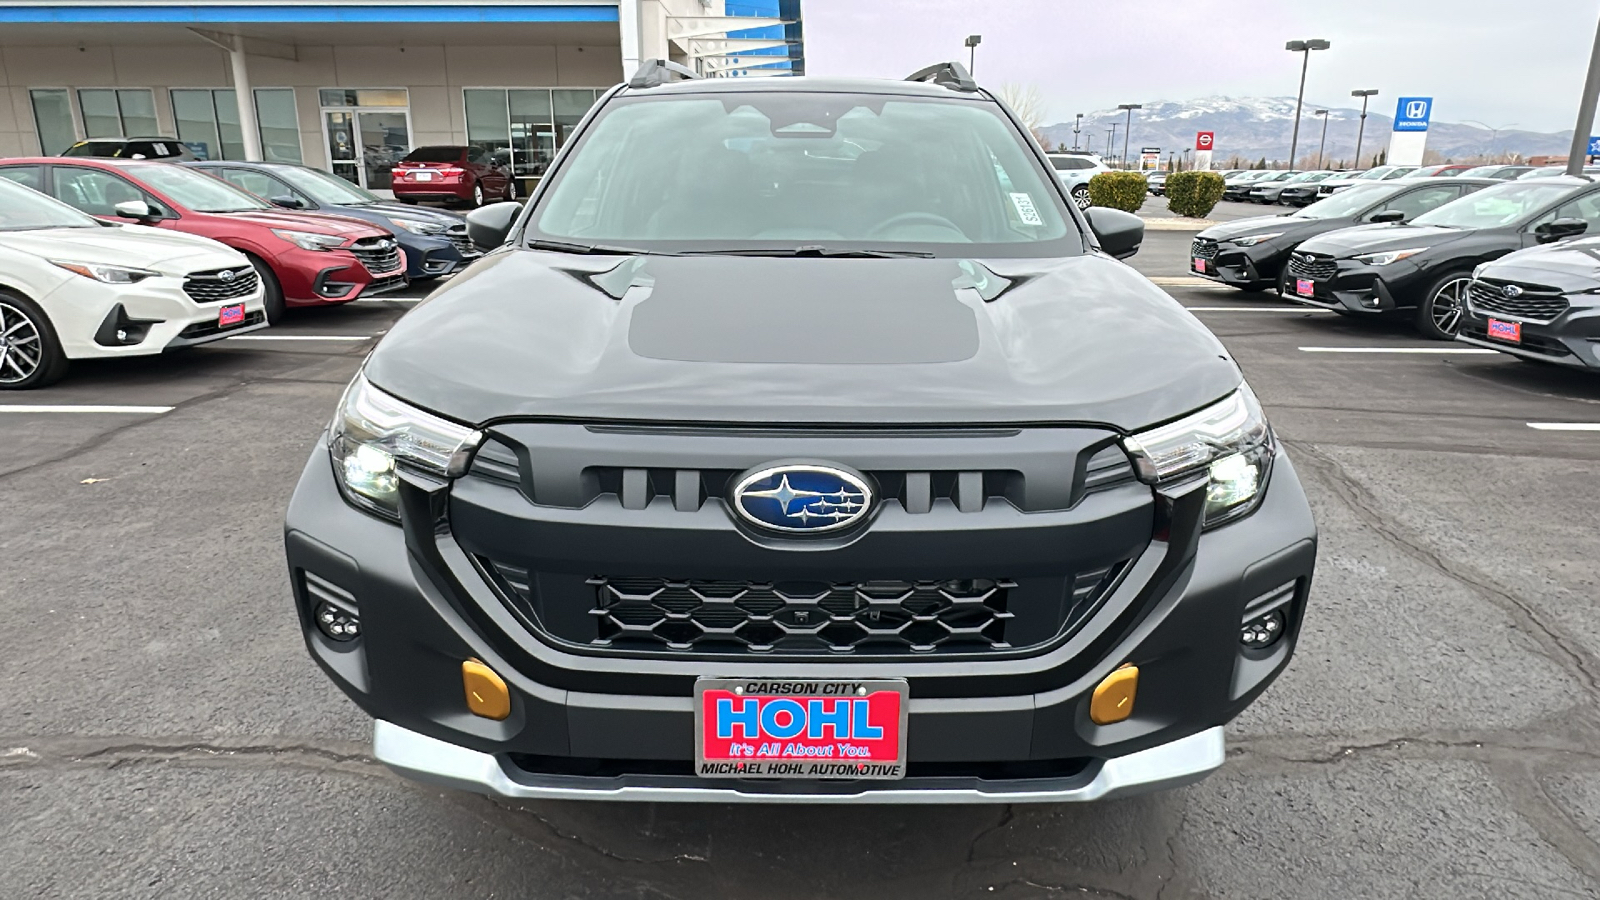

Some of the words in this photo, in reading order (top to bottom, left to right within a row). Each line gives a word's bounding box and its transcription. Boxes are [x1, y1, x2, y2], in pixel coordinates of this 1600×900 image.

[745, 682, 818, 694] CARSON
[822, 683, 861, 695] CITY
[717, 699, 883, 739] HOHL
[729, 742, 754, 756] It's
[757, 743, 780, 756] All
[783, 743, 832, 756] About
[837, 743, 871, 757] You.
[701, 763, 763, 774] MICHAEL
[767, 764, 805, 775] HOHL
[808, 764, 900, 776] AUTOMOTIVE
